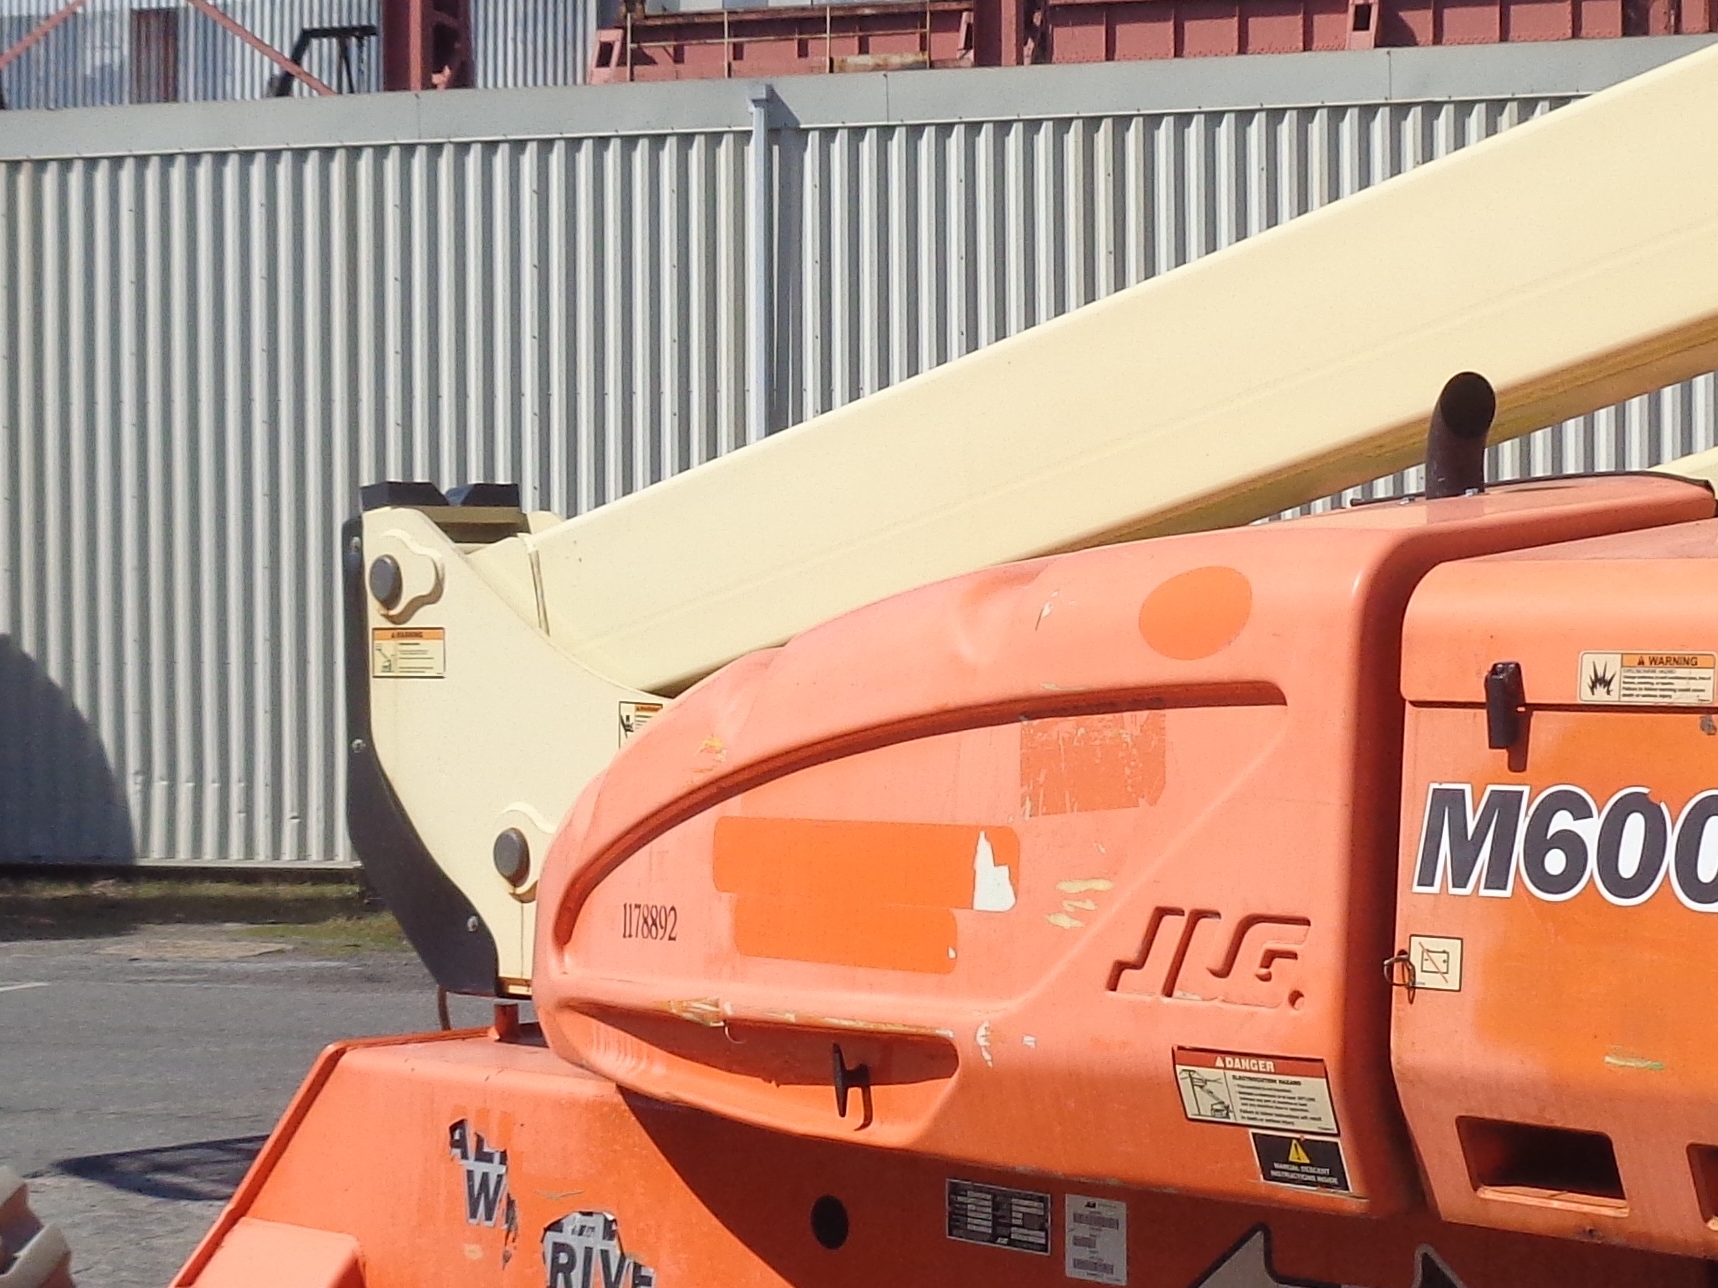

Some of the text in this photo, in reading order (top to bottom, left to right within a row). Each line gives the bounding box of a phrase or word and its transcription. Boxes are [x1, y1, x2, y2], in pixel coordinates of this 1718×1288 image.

[1648, 655, 1699, 667] WARNING
[622, 902, 678, 942] 1178892
[1225, 1056, 1275, 1073] DANGER
